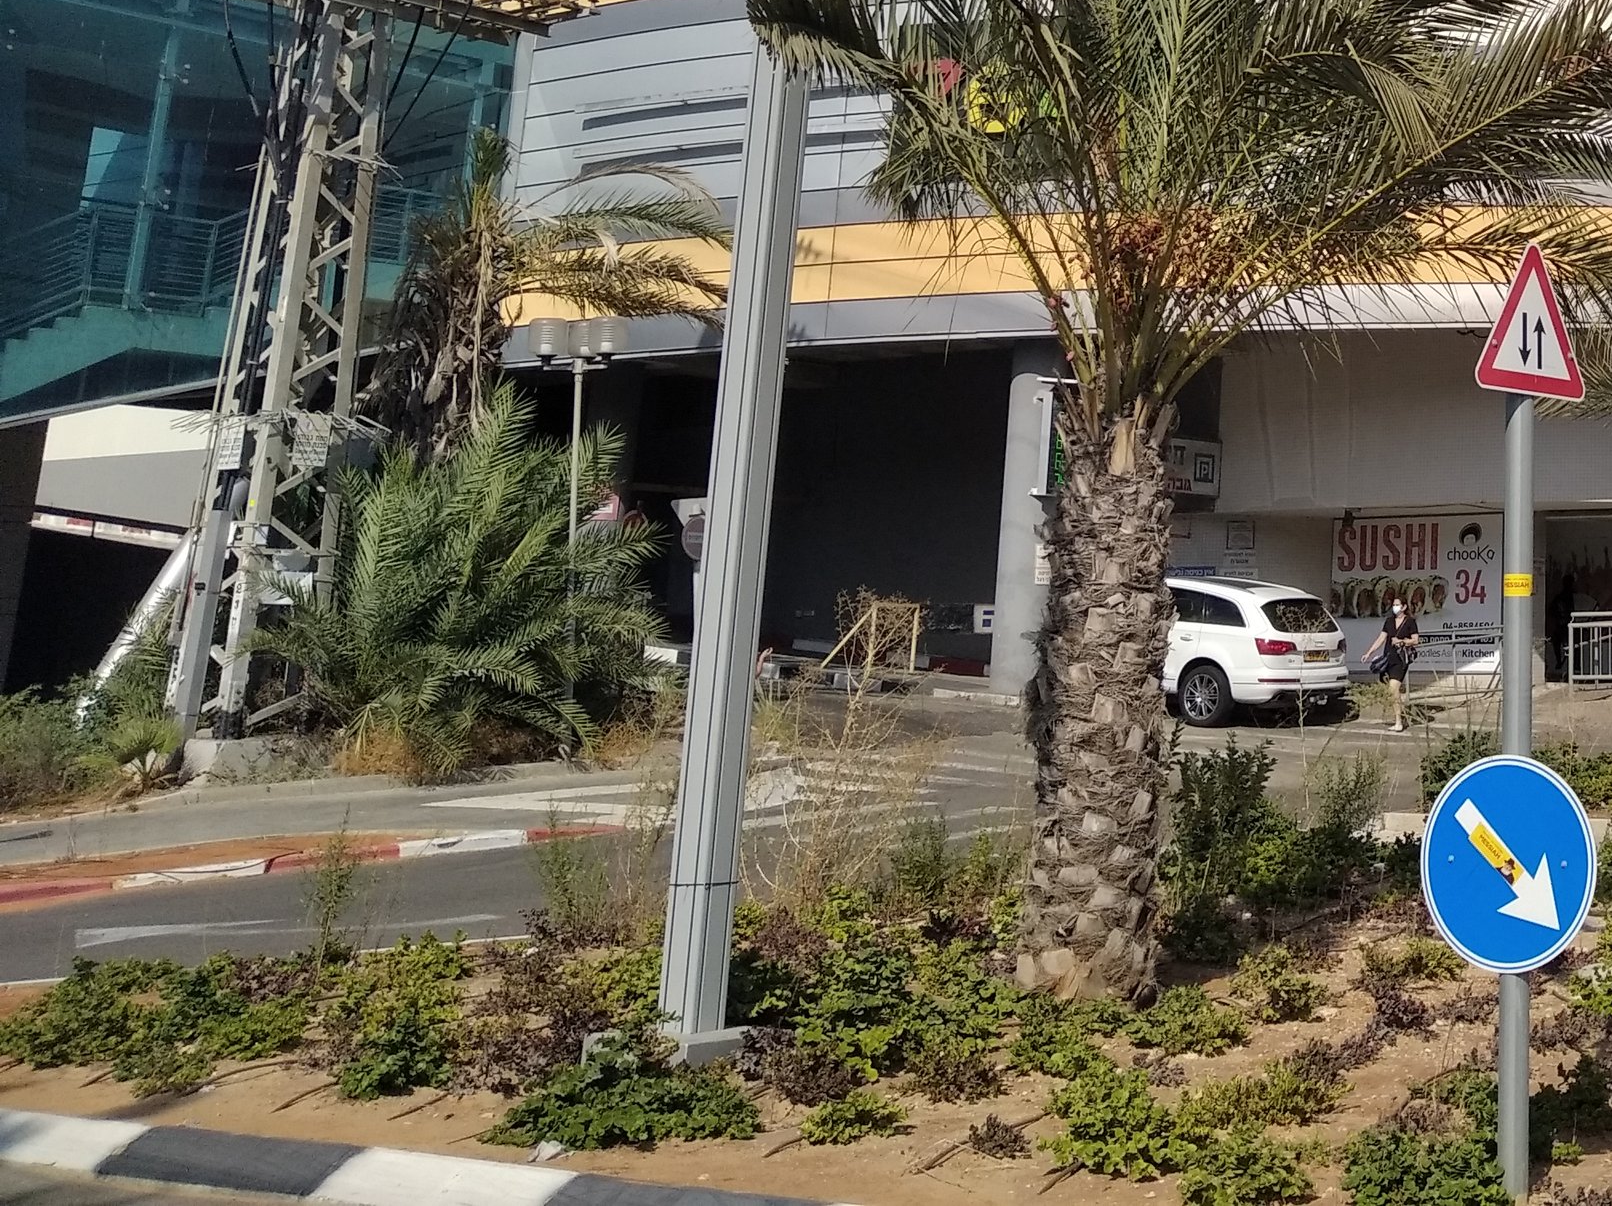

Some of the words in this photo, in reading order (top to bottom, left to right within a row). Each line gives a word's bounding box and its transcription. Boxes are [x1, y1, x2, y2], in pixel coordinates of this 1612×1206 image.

[1337, 523, 1439, 571] SUSHI
[1455, 569, 1487, 605] 34
[1462, 648, 1495, 658] Kitchen
